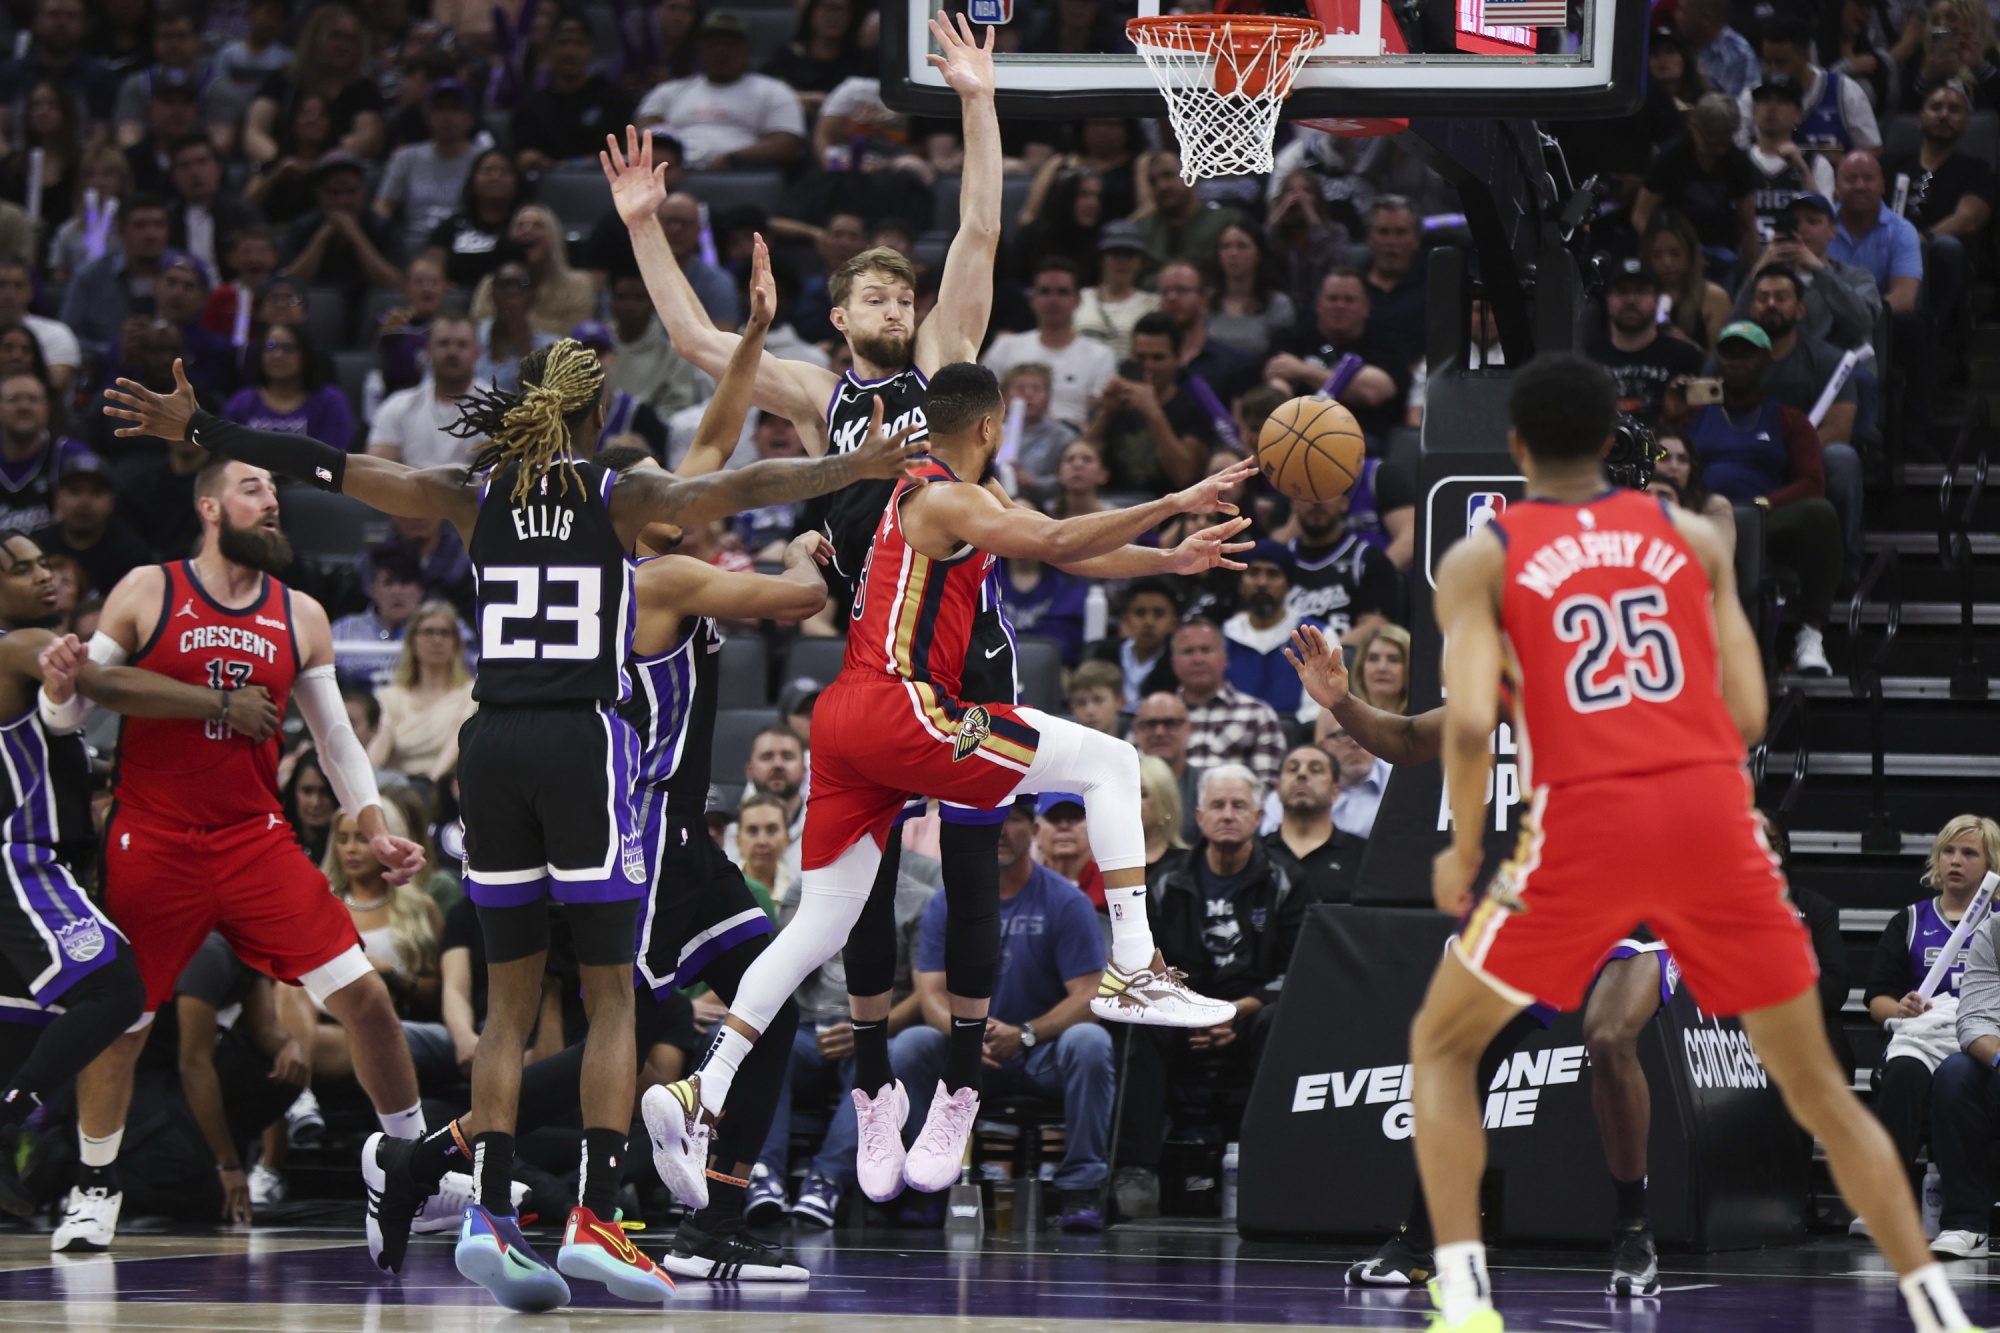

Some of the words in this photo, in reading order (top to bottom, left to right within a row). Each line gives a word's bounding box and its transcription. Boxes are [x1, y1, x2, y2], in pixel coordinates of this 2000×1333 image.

[975, 1, 997, 17] NBA
[511, 504, 575, 541] ELLIS
[1516, 530, 1643, 600] MURPHY
[481, 565, 604, 661] 23
[179, 625, 278, 665] CRESCENT
[1552, 584, 1685, 714] 25
[205, 657, 253, 690] 17
